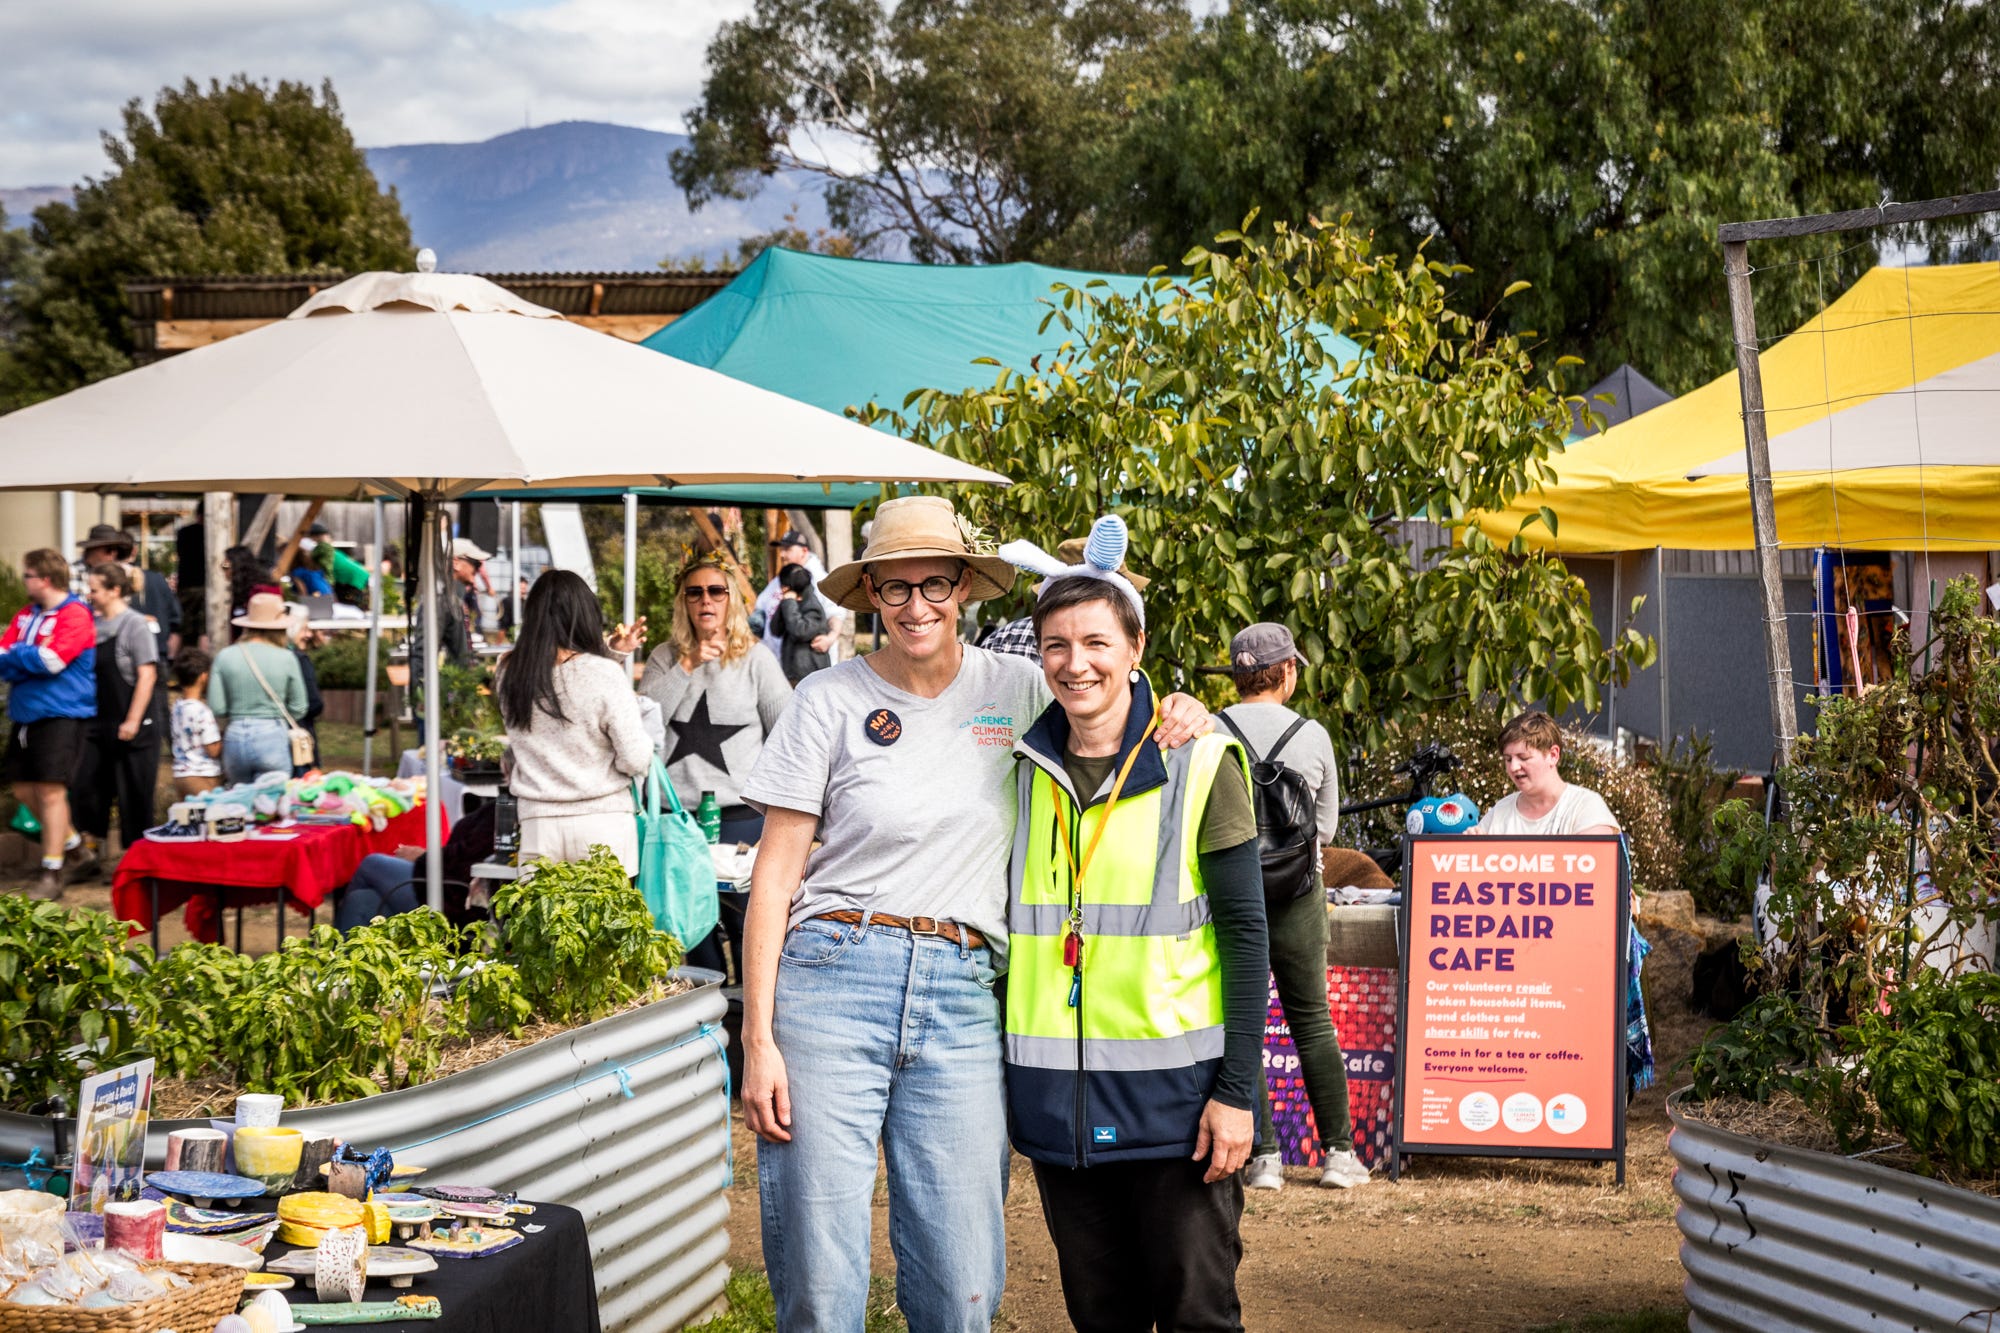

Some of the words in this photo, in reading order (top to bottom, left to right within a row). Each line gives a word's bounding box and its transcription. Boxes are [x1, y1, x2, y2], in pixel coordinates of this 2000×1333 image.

[870, 711, 888, 730] NAT
[971, 726, 1013, 737] CLIMATE
[977, 737, 1014, 748] ACTION
[1431, 854, 1554, 873] WELCOME
[1563, 854, 1596, 873] TO
[1431, 882, 1594, 906] EASTSIDE
[1430, 915, 1554, 939] REPAIR
[1428, 947, 1515, 972] CAFE
[1426, 980, 1449, 992] Our
[1452, 981, 1513, 993] volunteers
[1515, 982, 1552, 995] repair
[1425, 996, 1466, 1007] broken
[1469, 997, 1526, 1008] household
[1530, 997, 1566, 1011] items,
[1425, 1011, 1457, 1023] mend
[1460, 1012, 1500, 1024] clothes
[1504, 1013, 1525, 1024] and
[1424, 1027, 1456, 1039] share
[1460, 1027, 1490, 1040] skills
[1492, 1028, 1510, 1039] for
[1513, 1028, 1541, 1040] free.
[1424, 1047, 1456, 1058] Come
[1460, 1047, 1471, 1058] in
[1475, 1047, 1492, 1059] for
[1507, 1049, 1525, 1059] tea
[1529, 1051, 1542, 1060] or
[1545, 1050, 1584, 1061] coffee.
[1424, 1063, 1474, 1075] Everyone
[1478, 1063, 1528, 1074] welcome.
